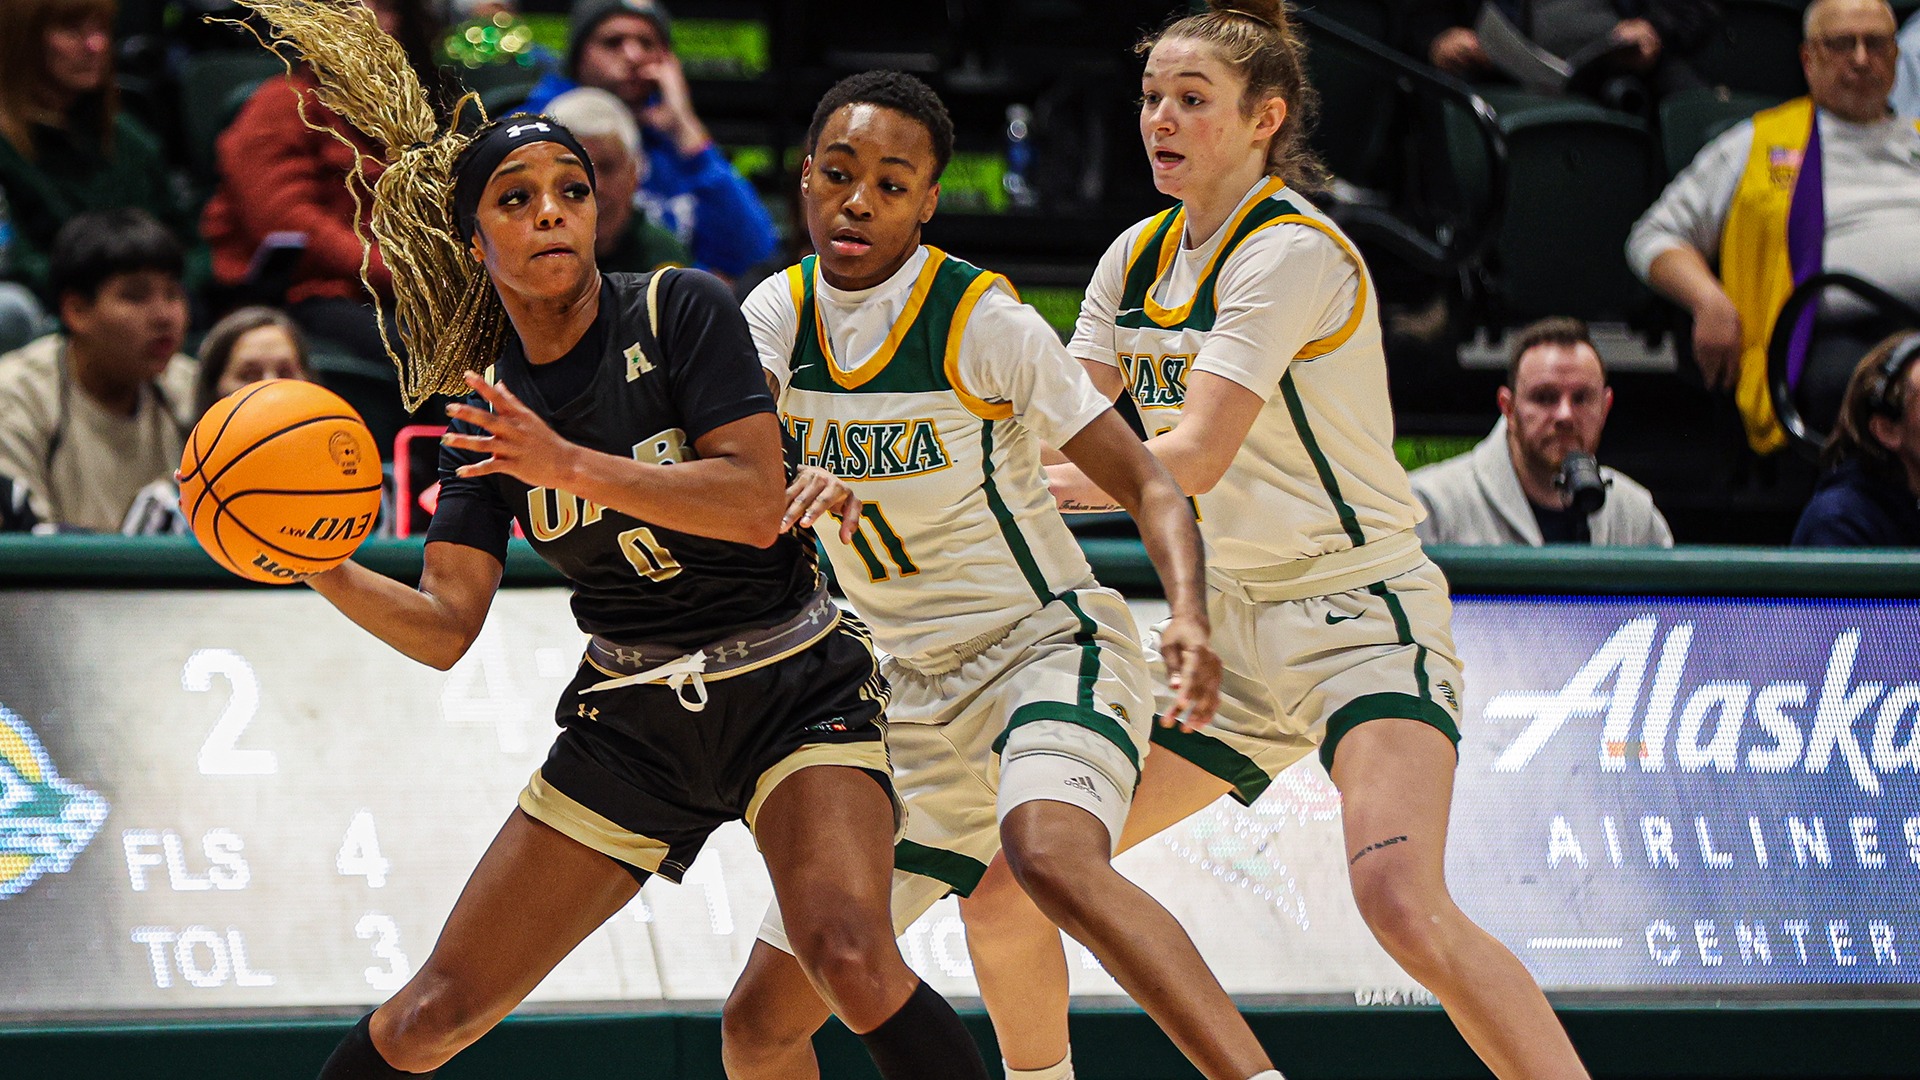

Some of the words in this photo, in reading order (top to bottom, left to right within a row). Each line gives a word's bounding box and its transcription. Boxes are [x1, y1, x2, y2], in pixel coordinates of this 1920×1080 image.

[623, 342, 656, 383] A
[279, 525, 306, 538] NXT
[306, 511, 372, 541] EVO
[617, 526, 683, 583] 0
[826, 500, 920, 583] 11
[181, 648, 278, 774] 2
[1483, 613, 1920, 797] Alaska
[122, 827, 250, 891] FLS
[335, 807, 391, 888] 4
[130, 923, 277, 988] TOL
[355, 910, 410, 991] 3
[1646, 919, 1901, 966] CENTER
